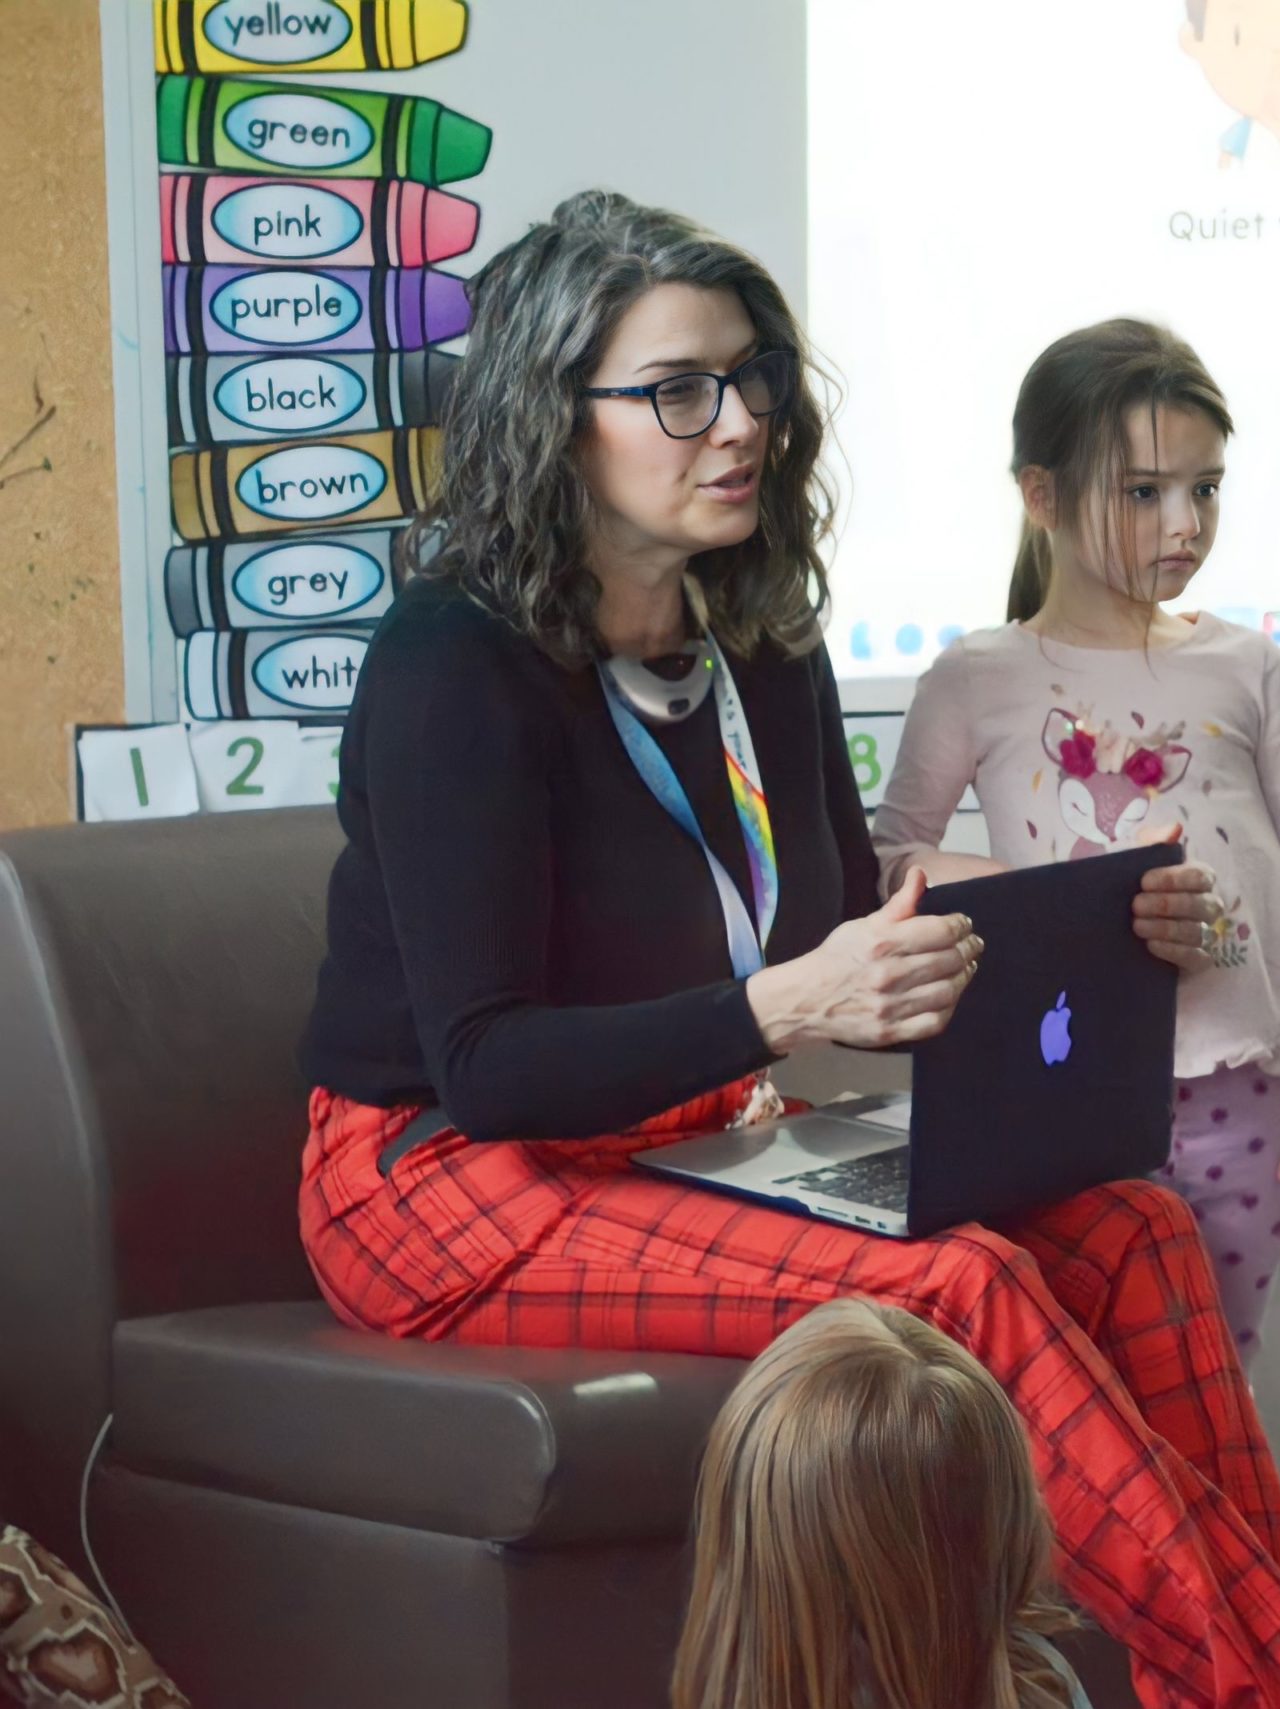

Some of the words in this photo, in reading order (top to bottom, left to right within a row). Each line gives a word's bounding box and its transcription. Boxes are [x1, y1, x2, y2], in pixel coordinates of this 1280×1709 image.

[223, 2, 331, 47] yellow
[248, 118, 350, 149] green
[254, 205, 320, 245] pink
[1169, 211, 1264, 241] Quiet
[230, 283, 342, 329] purple
[246, 375, 337, 412] black
[256, 470, 369, 505] brown
[267, 570, 349, 605] grey
[282, 655, 358, 689] whit
[130, 748, 148, 806] 1
[226, 737, 263, 795] 2
[848, 733, 882, 792] 8
